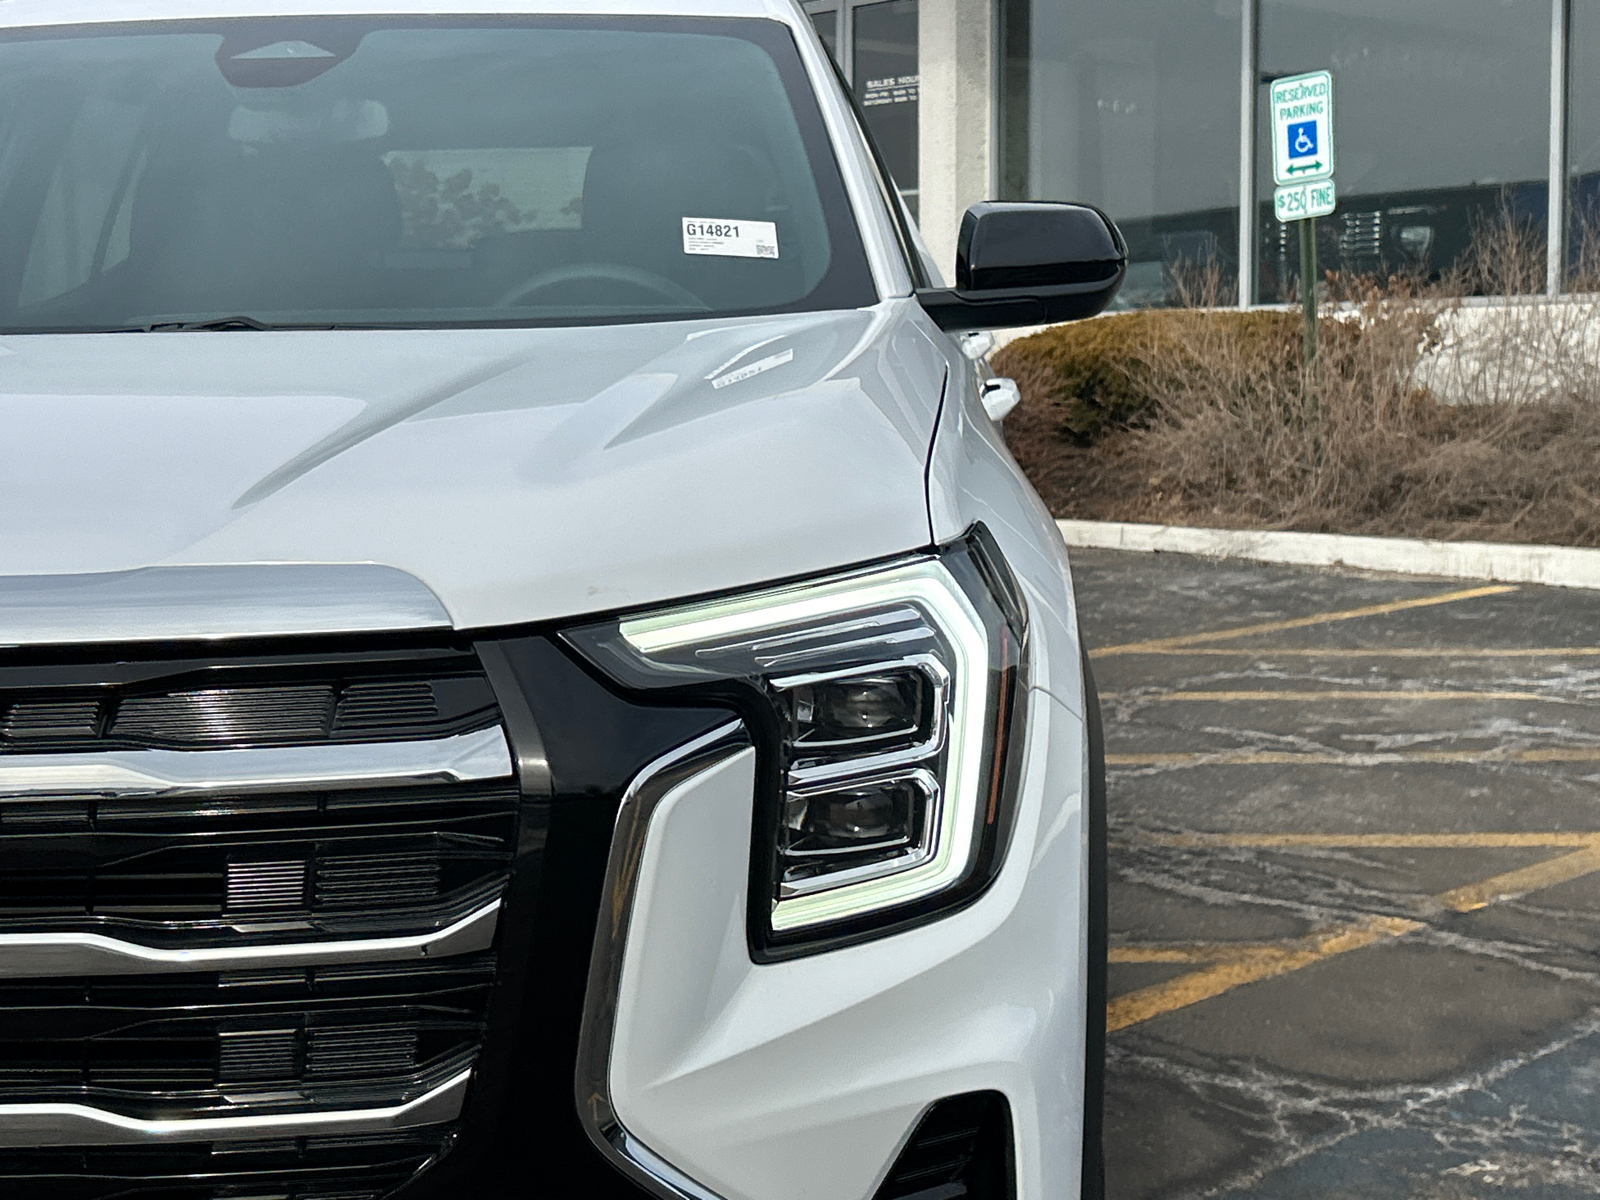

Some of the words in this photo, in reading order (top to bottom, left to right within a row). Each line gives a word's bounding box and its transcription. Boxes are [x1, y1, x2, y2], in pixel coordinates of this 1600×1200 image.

[866, 78, 895, 88] SALES
[1275, 83, 1327, 104] RESERVED
[1280, 101, 1324, 121] PARKING
[1277, 190, 1307, 212] $250
[1310, 186, 1334, 208] FINE
[687, 223, 740, 238] G14821
